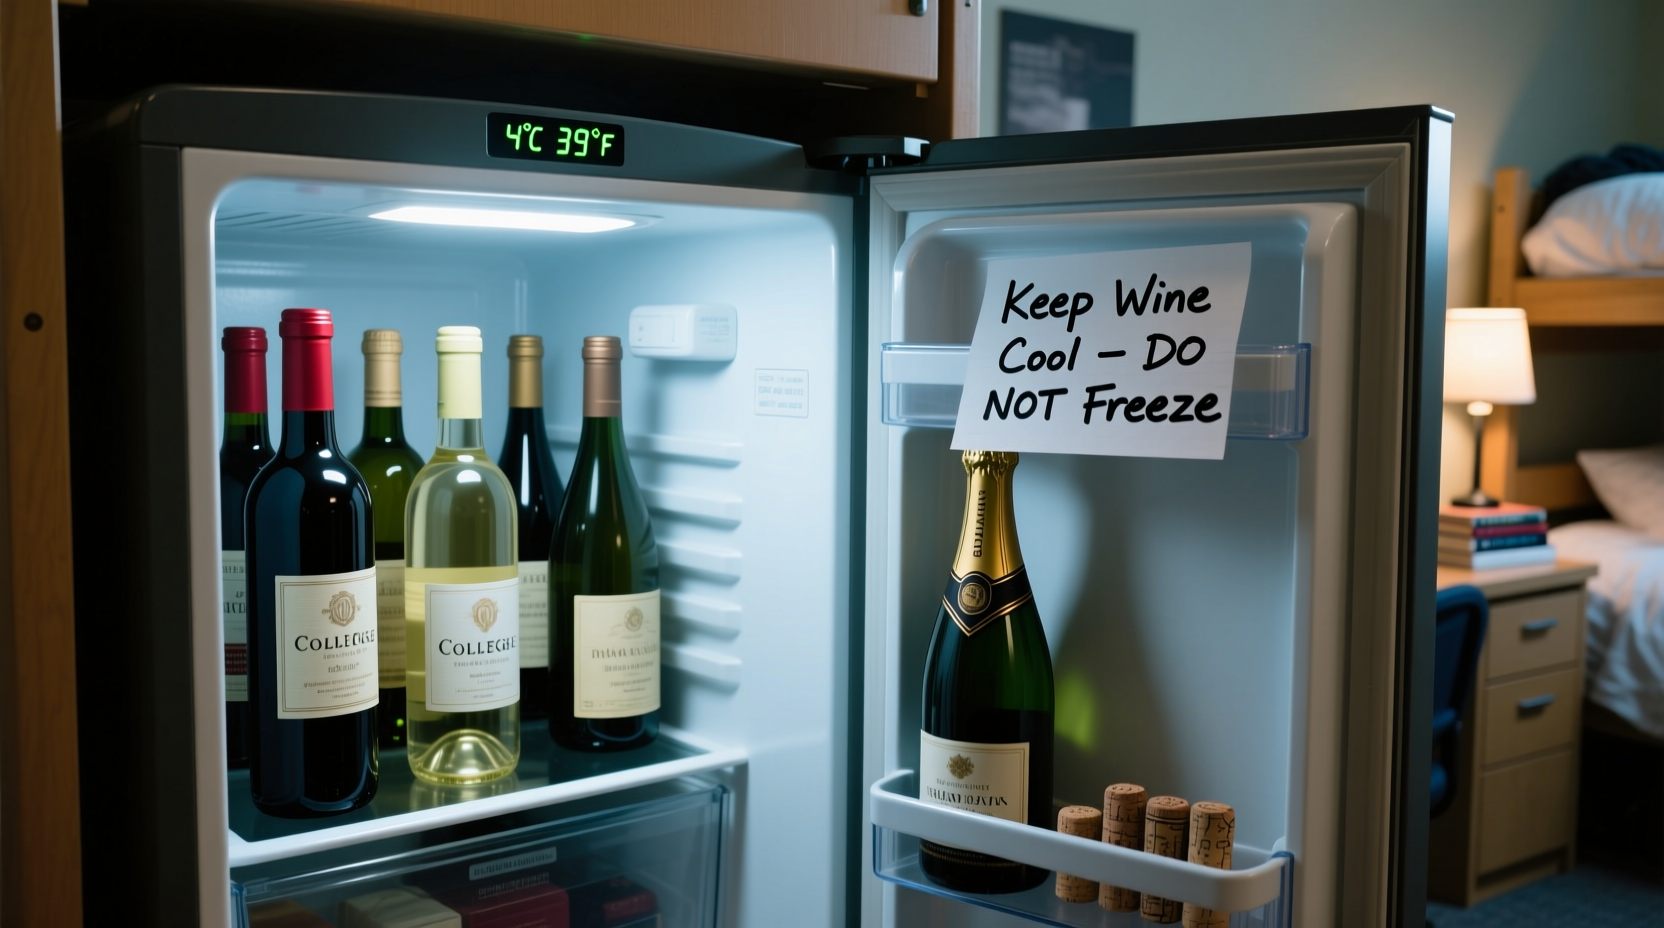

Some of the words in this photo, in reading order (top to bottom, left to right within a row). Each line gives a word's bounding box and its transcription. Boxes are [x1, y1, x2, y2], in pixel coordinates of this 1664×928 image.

[506, 122, 544, 152] 4°C
[556, 127, 615, 157] 39°F
[1001, 279, 1094, 333] Keep
[1115, 273, 1212, 317] Wine
[998, 336, 1082, 374] Cool
[1142, 333, 1207, 371] DO
[982, 386, 1069, 421] NOT
[1082, 382, 1223, 425] Freeze
